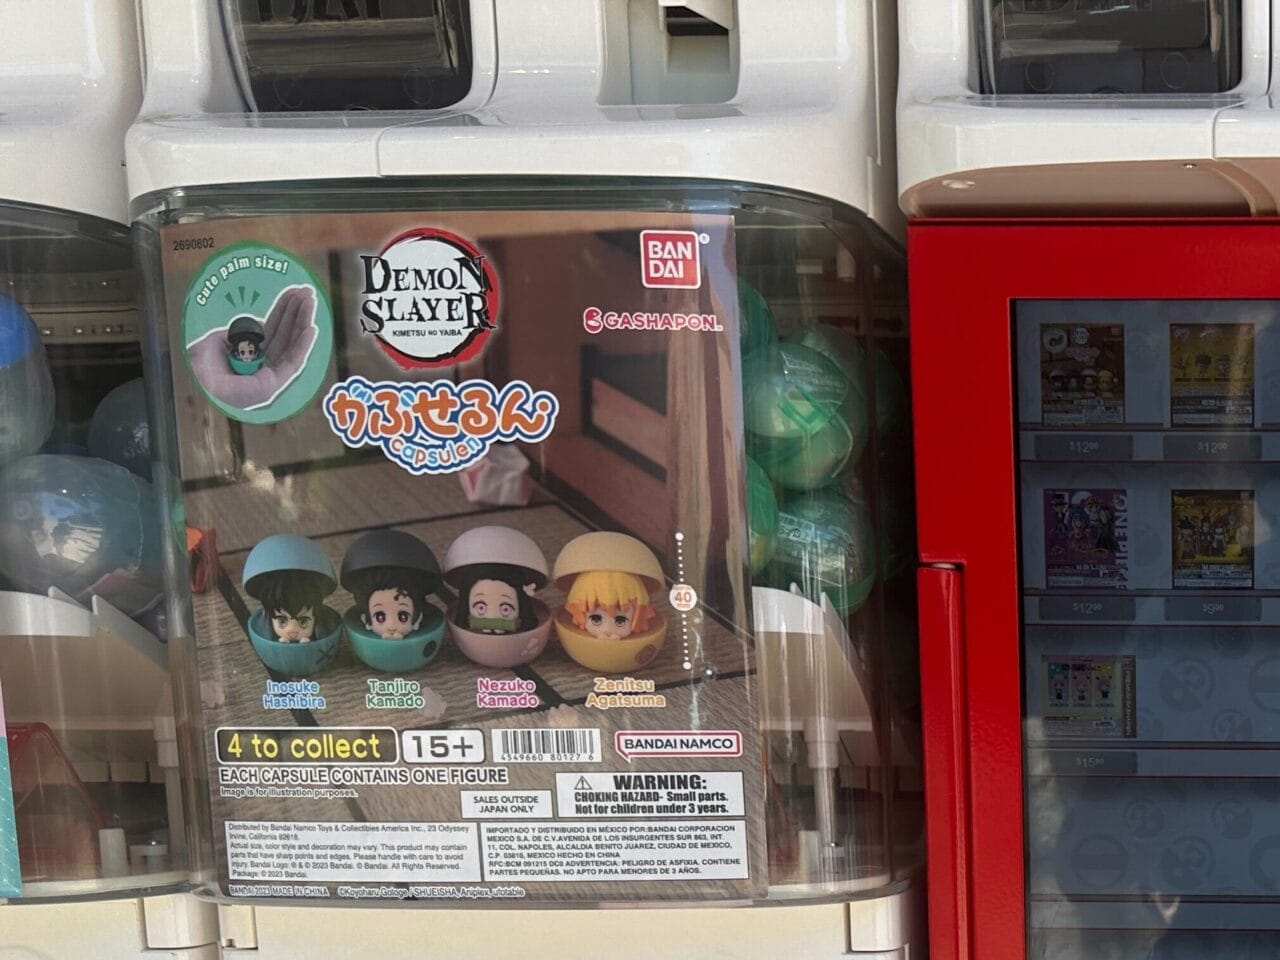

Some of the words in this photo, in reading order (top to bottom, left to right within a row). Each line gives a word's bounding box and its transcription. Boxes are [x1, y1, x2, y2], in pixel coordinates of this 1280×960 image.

[173, 238, 215, 251] 2690802
[648, 241, 692, 259] BAN
[360, 255, 494, 294] DEMON
[649, 260, 684, 278] DAI
[196, 275, 219, 306] Cute
[220, 257, 250, 279] palm
[255, 255, 289, 274] size!
[361, 292, 496, 333] SLAYER
[392, 329, 427, 337] KIMETSU
[439, 329, 463, 337] YAIBA
[390, 436, 481, 466] capsulen
[267, 679, 319, 694] Inosuke
[368, 679, 420, 695] Tanjiro
[478, 678, 536, 692] Nezuko
[594, 678, 655, 692] Zenitsu
[263, 693, 326, 709] Hashibira
[366, 694, 425, 708] Kamado
[478, 693, 539, 707] Kamado
[586, 692, 666, 709] Agatsuma
[227, 733, 242, 758] 4
[251, 733, 279, 758] to
[290, 733, 381, 758] collect
[411, 735, 474, 758] 15+
[624, 738, 678, 750] BANDAI
[680, 738, 734, 750] NAMCO
[220, 769, 258, 784] EACH
[261, 769, 329, 784] CAPSULE
[331, 769, 409, 784] CONTAINS
[413, 769, 447, 784] ONE
[451, 769, 508, 784] FIGURE
[613, 775, 707, 791] WARNING:
[473, 794, 500, 804] SALES
[501, 794, 539, 804] OUTSIDE
[574, 791, 620, 803] CHOKING
[667, 791, 697, 802] Small
[698, 791, 729, 805] parts.
[479, 804, 508, 814] JAPAN
[510, 804, 534, 814] ONLY
